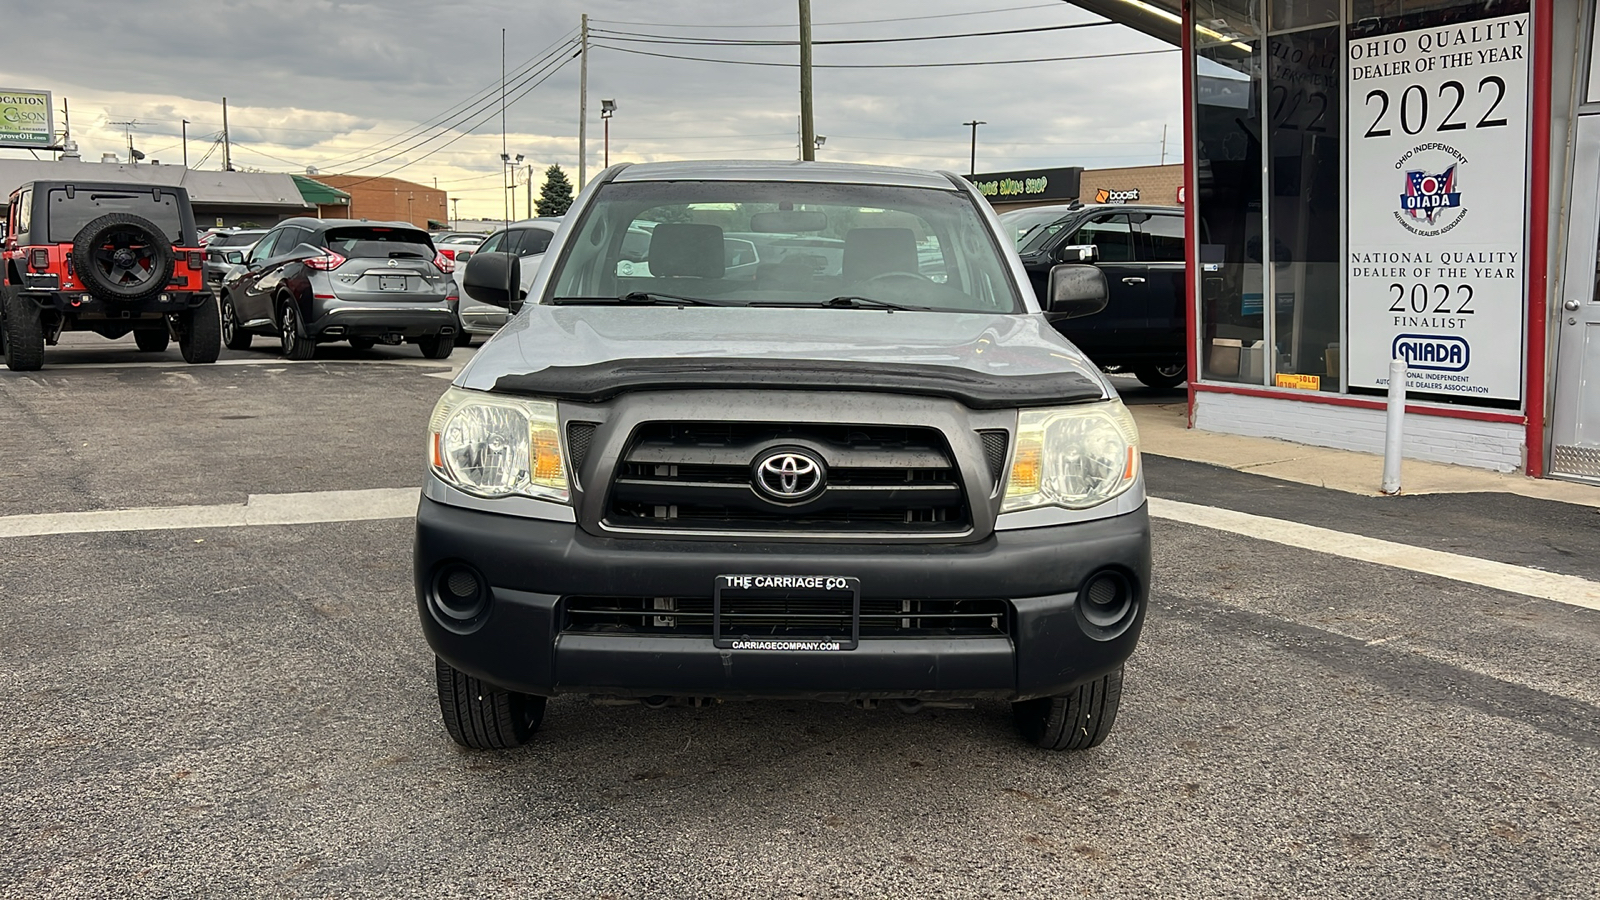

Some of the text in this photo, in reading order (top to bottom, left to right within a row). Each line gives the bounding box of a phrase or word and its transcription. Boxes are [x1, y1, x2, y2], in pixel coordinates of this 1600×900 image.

[1350, 38, 1407, 60] OHIO
[1418, 19, 1527, 53] QUALITY
[1352, 60, 1411, 81] DEALER
[1415, 57, 1436, 73] OF
[1440, 52, 1473, 69] THE
[1477, 45, 1523, 64] YEAR
[0, 96, 44, 105] CATION
[1364, 75, 1508, 138] 2022
[1395, 142, 1468, 170] OHIO INDEPENDENT
[1025, 176, 1048, 194] SHOP
[1109, 188, 1139, 200] boost
[1407, 194, 1450, 208] OIADA
[1393, 207, 1468, 237] AUTOMOBILE DEALERS ASSOCIATION
[1351, 252, 1518, 265] NATIONAL QUALITY
[1353, 267, 1516, 279] DEALER OF THE YEAR
[1388, 283, 1475, 314] 2022
[1393, 316, 1467, 329] FINALIST
[1398, 342, 1462, 364] NIADA
[1299, 375, 1317, 384] SOLD
[1406, 371, 1469, 382] ONAL INDEPENDENT
[1415, 381, 1443, 389] DEALERS
[1443, 384, 1489, 393] ASSOCIATION
[725, 576, 849, 589] THE CARRIAGE CO.
[732, 641, 840, 651] CARRIAGECOMPANY.COM
